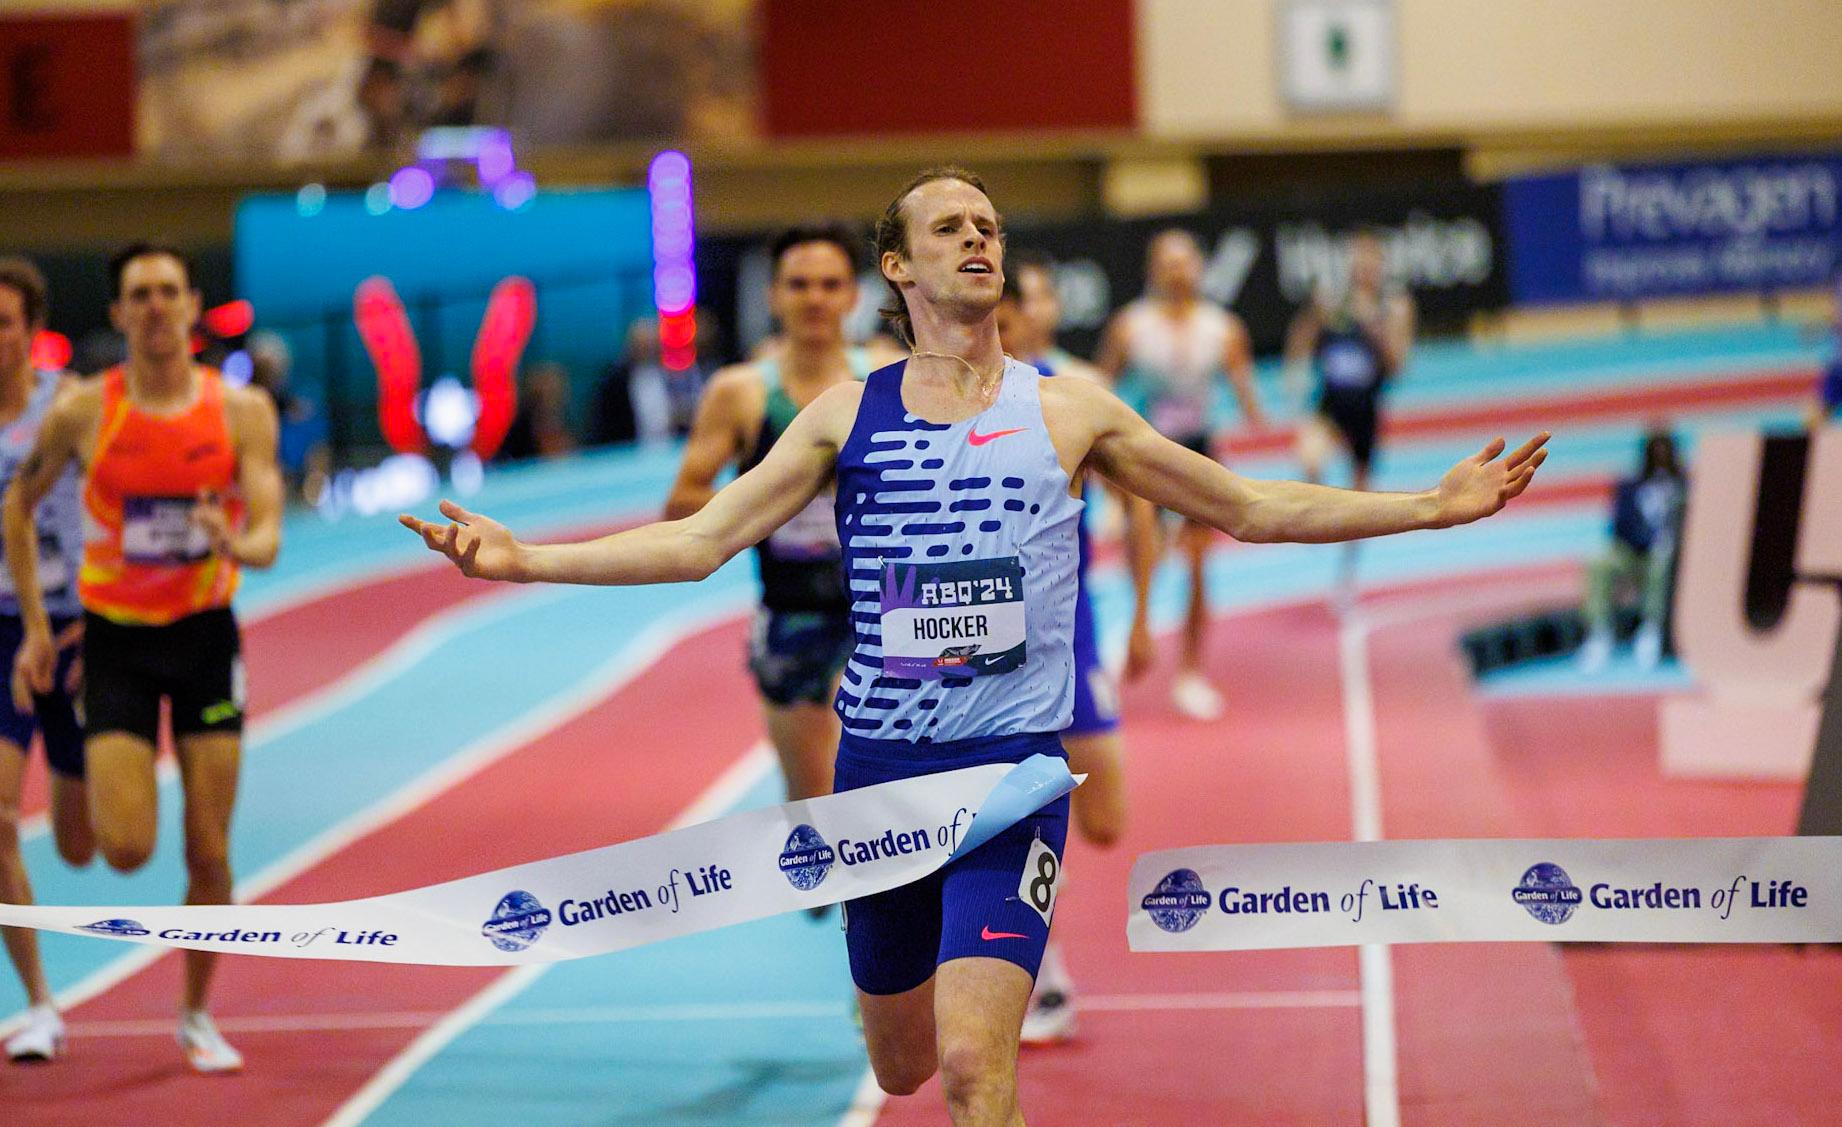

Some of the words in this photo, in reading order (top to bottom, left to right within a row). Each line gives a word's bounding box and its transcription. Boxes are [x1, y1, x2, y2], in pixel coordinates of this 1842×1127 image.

[913, 614, 988, 640] HOCKER
[837, 827, 930, 867] Garden
[937, 807, 967, 857] of
[780, 855, 808, 867] Garden
[818, 850, 832, 860] Life
[558, 888, 653, 926] Garden
[657, 869, 680, 913] of
[684, 864, 732, 897] Life
[1029, 852, 1056, 913] 8
[1145, 895, 1177, 905] Garden
[1191, 894, 1208, 904] Life
[1515, 891, 1548, 900] Garden
[1561, 891, 1578, 900] Life
[1590, 883, 1701, 909] Garden
[1711, 875, 1746, 919] of
[1750, 880, 1808, 908] Life
[1219, 886, 1331, 914] Garden
[1340, 879, 1373, 922] of
[1378, 884, 1438, 911] Life
[158, 928, 281, 943] Garden
[291, 927, 336, 948] of
[335, 930, 398, 946] Life
